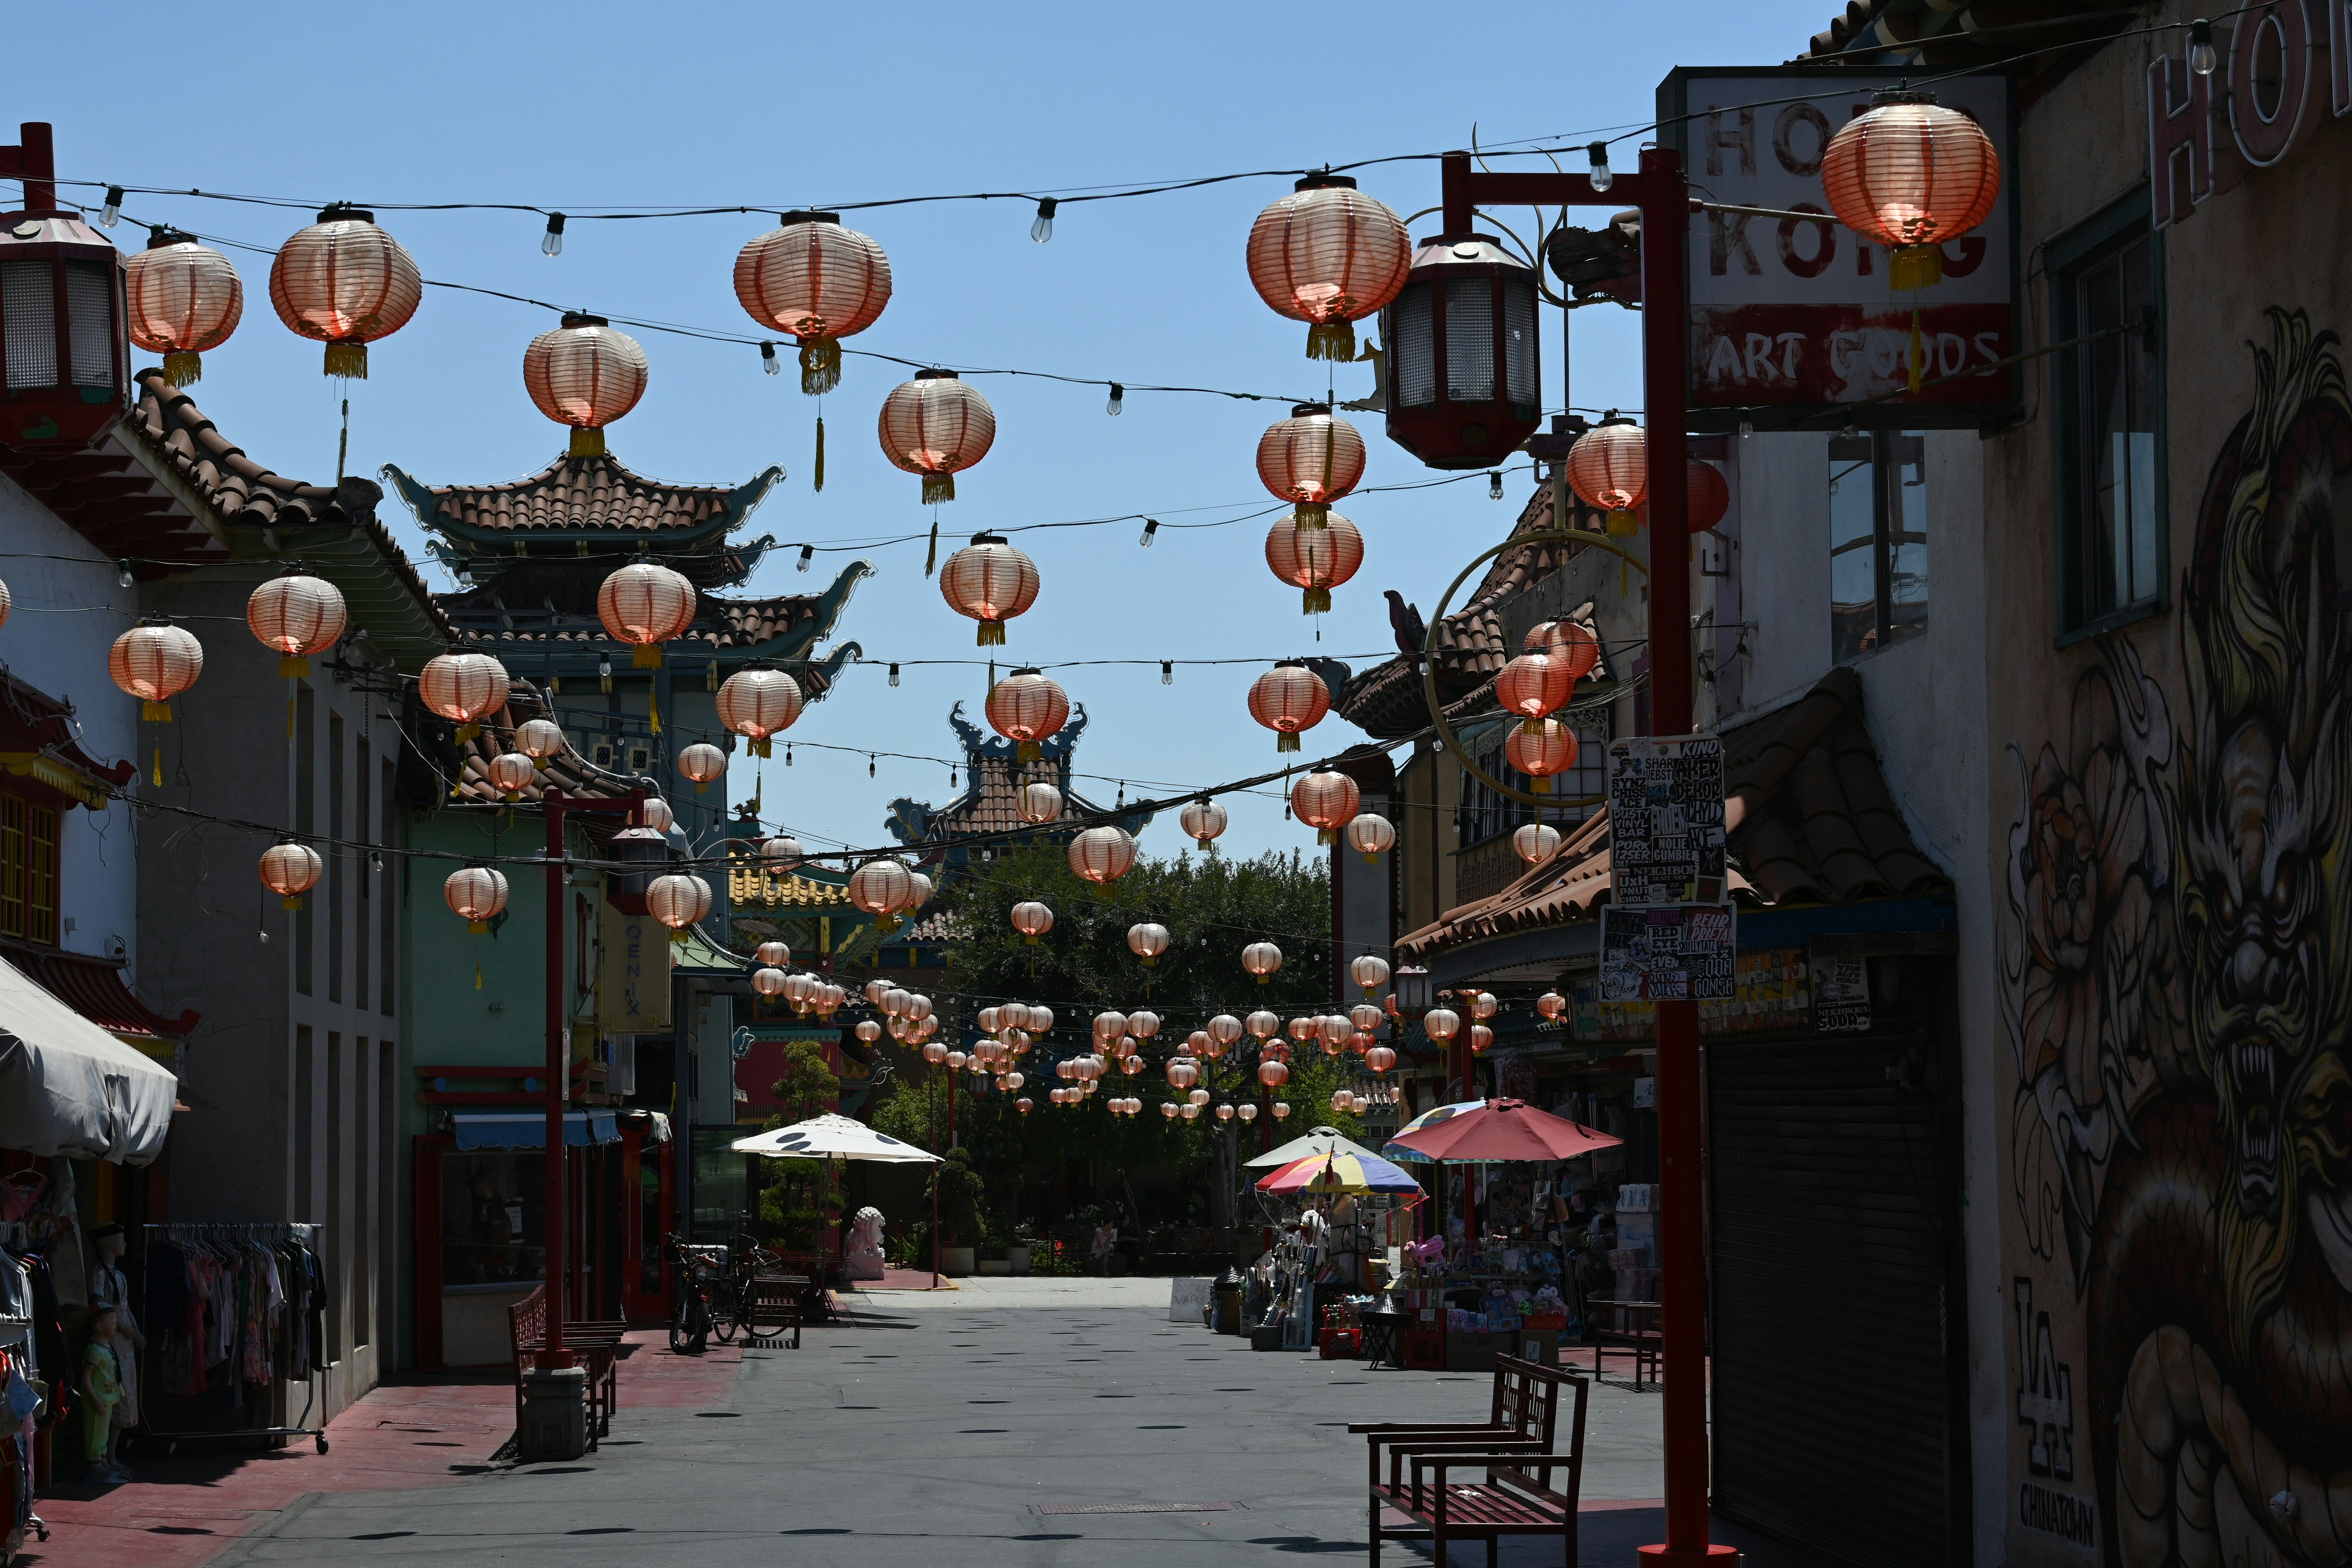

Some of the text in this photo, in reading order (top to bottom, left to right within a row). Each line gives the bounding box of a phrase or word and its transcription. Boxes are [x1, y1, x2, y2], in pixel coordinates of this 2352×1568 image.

[1708, 331, 2000, 381] ART GOODS
[1682, 740, 1719, 756] KIND
[1674, 758, 1720, 782] AKER
[1611, 777, 1646, 788] SYNZ
[1611, 788, 1646, 799] CHISS
[1675, 781, 1720, 802] DEKOR
[1617, 798, 1642, 809] ACE
[1613, 810, 1650, 819] DUSTY
[1615, 819, 1649, 828] VINYL
[1618, 828, 1646, 838] BAR
[1615, 840, 1649, 850] PORK
[1659, 839, 1687, 849] NOLIE
[1654, 849, 1691, 860] GUMBIE
[1692, 914, 1729, 928] BEHR
[1652, 927, 1678, 938] RED
[1652, 938, 1678, 949] EYE
[1651, 956, 1679, 969] EVEN
[1818, 1006, 1868, 1016] NEIGHBORS
[1177, 1281, 1209, 1293] SMOKE
[1175, 1295, 1205, 1304] VAPES
[2020, 1482, 2094, 1548] CHINATOWN
